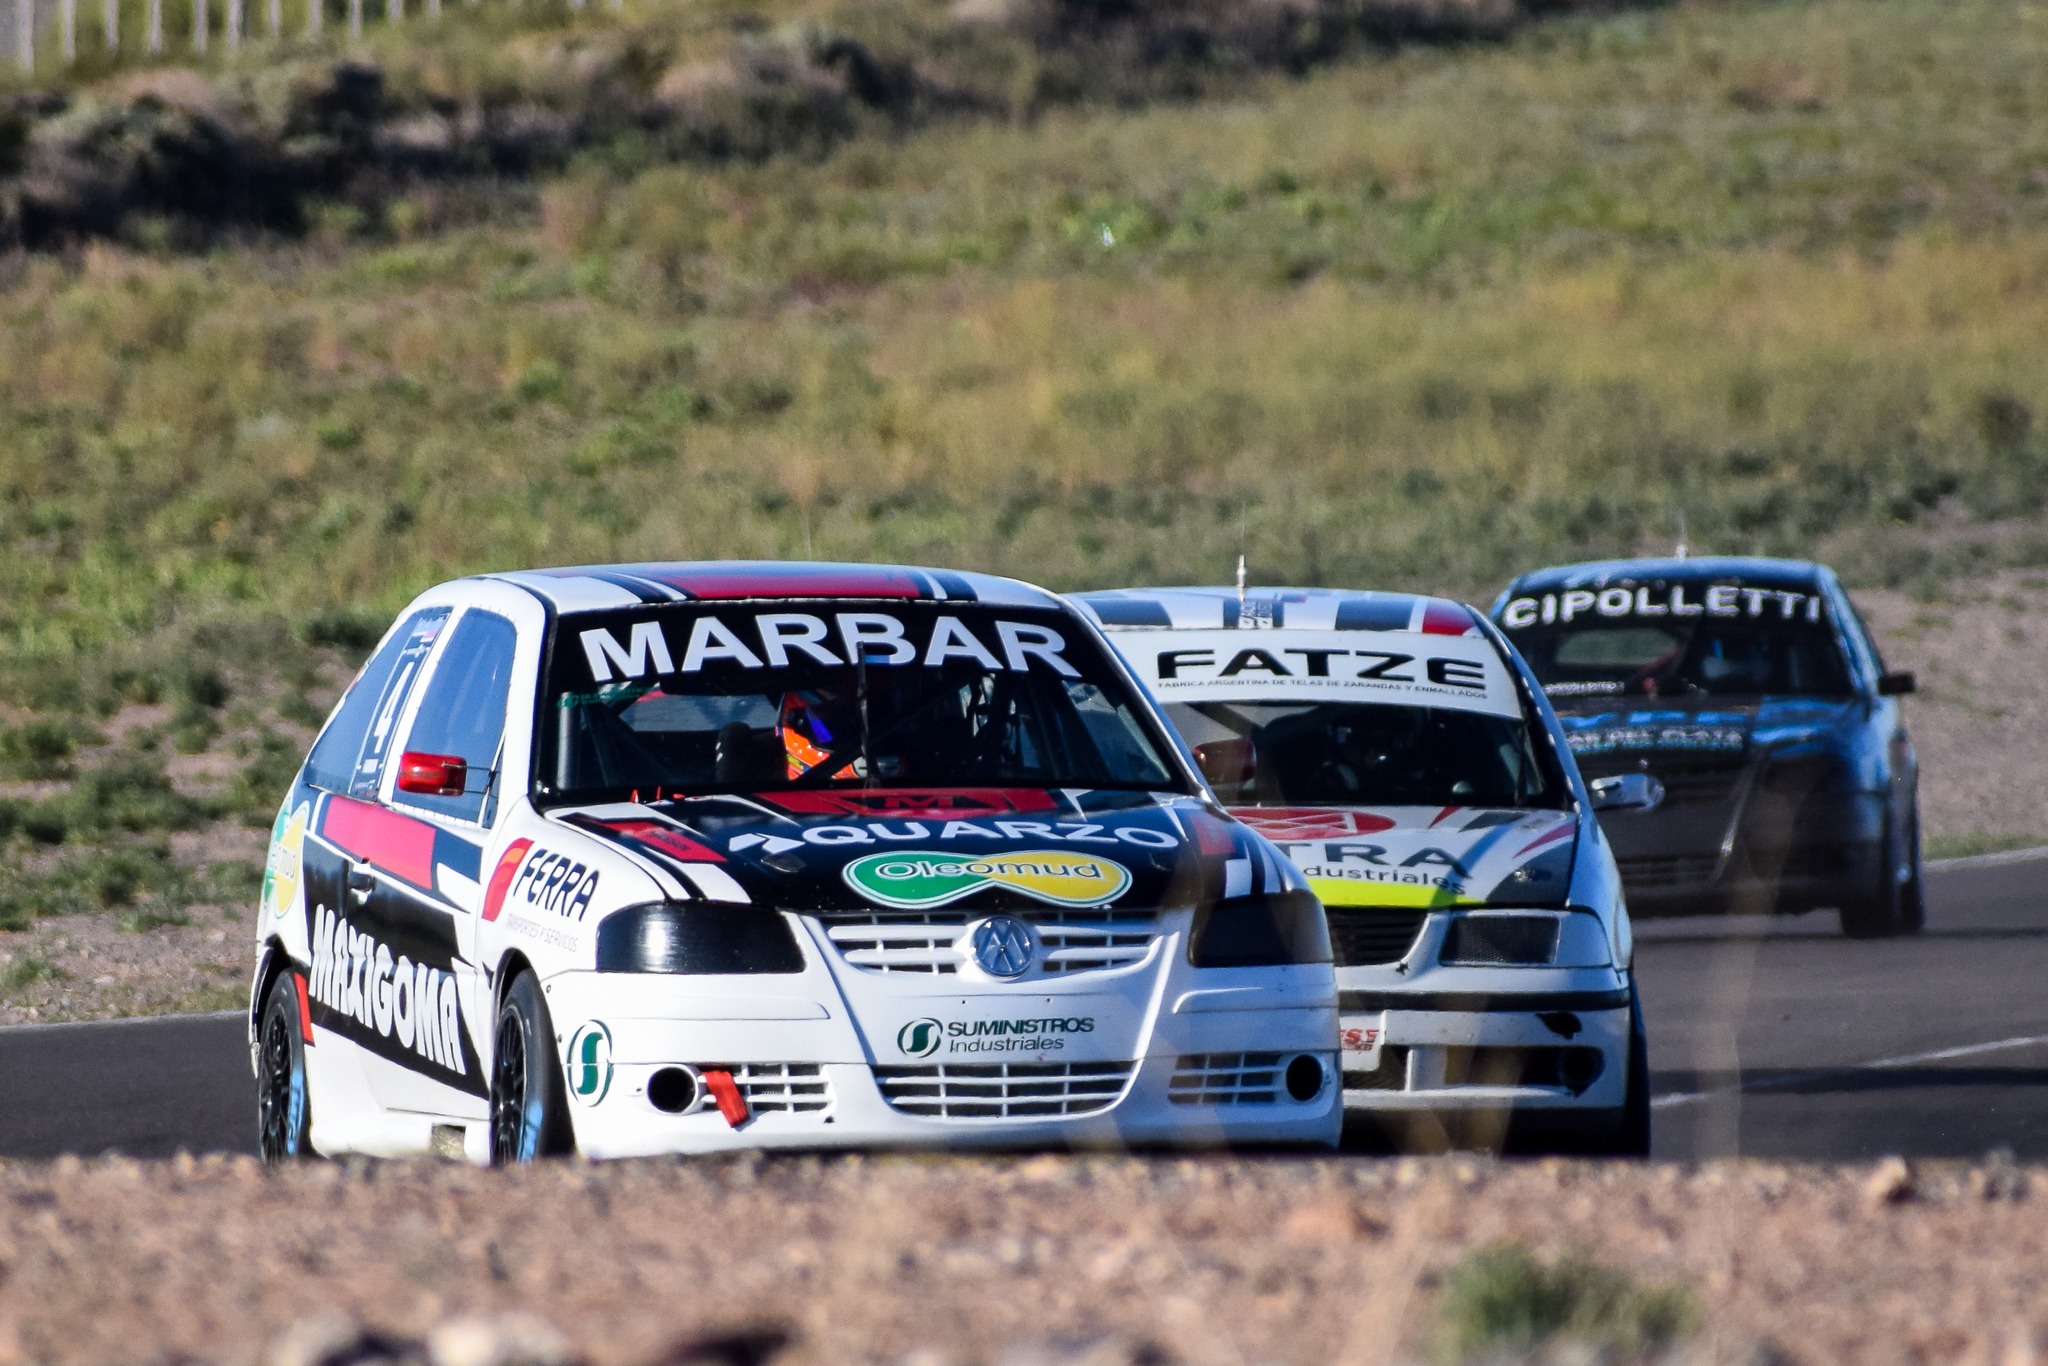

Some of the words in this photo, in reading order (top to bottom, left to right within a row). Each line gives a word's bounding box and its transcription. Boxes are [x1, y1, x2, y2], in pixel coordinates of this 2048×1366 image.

[1503, 585, 1820, 628] CIPOLLETTI
[579, 612, 1083, 683] MARBAR
[1157, 648, 1486, 690] FATZE
[1208, 679, 1268, 687] ARGENTINA
[1344, 682, 1401, 690] ZARANDAS
[802, 820, 1179, 849] QUARZO
[513, 848, 600, 922] FERRA
[1303, 865, 1466, 896] dustriales
[308, 903, 467, 1075] MAXIGOMA
[948, 1016, 1095, 1037] SUMINISTROS
[950, 1035, 1065, 1053] Industriales
